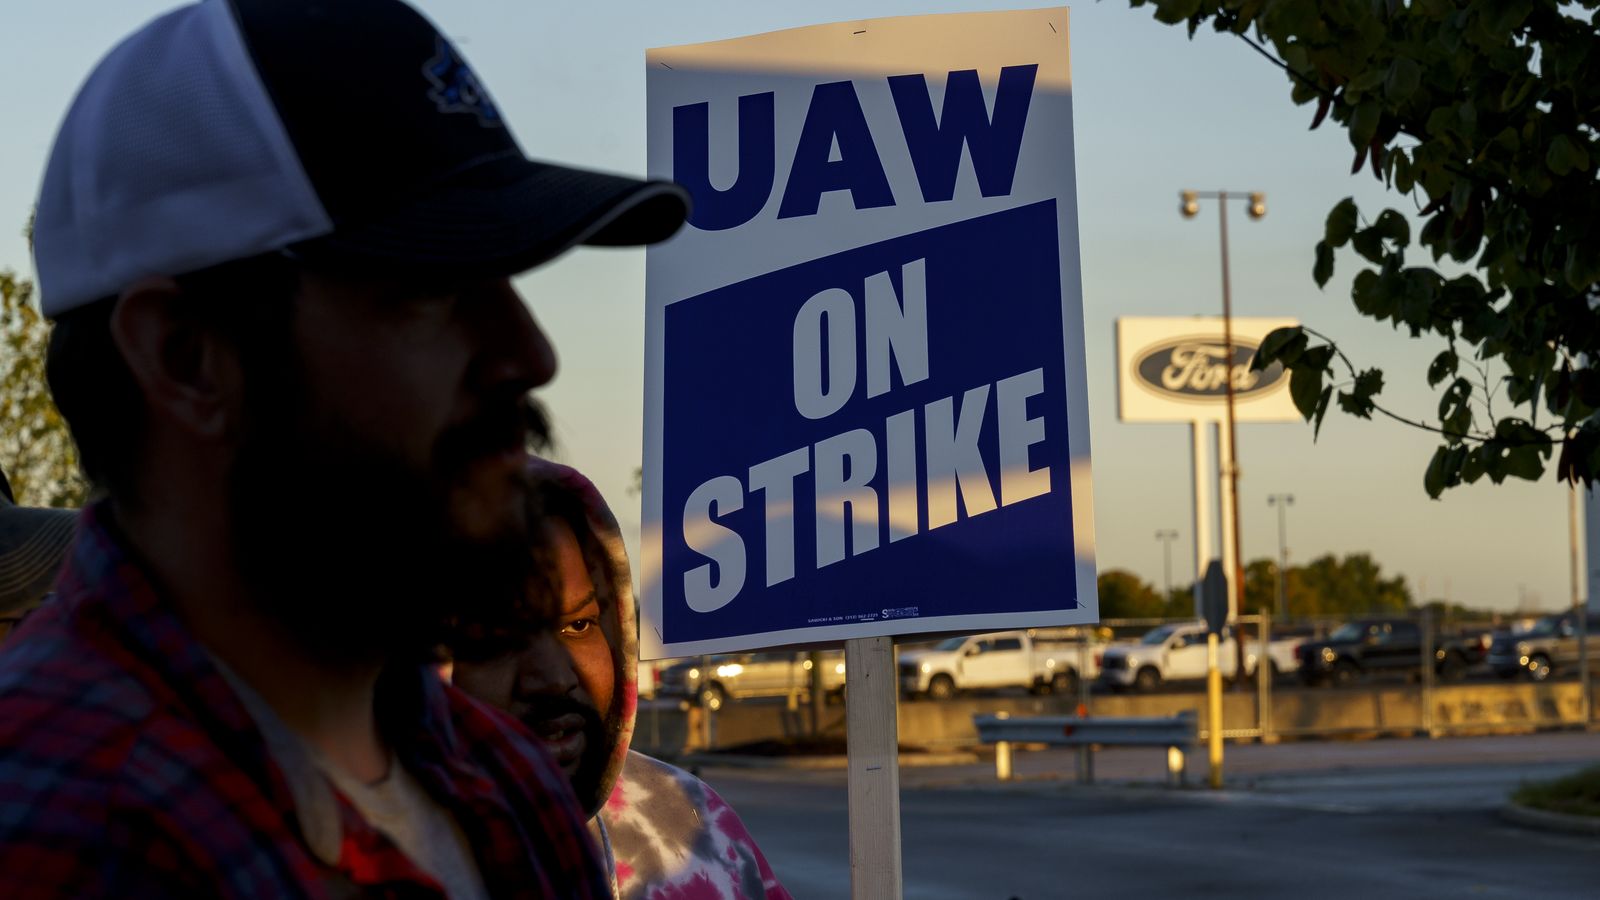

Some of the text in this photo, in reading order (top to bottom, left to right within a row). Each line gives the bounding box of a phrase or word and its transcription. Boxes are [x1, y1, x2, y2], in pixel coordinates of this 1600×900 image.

[673, 64, 1038, 231] UAW
[793, 258, 929, 419] ON
[1161, 343, 1259, 390] Ford
[682, 367, 1051, 613] STRIKE
